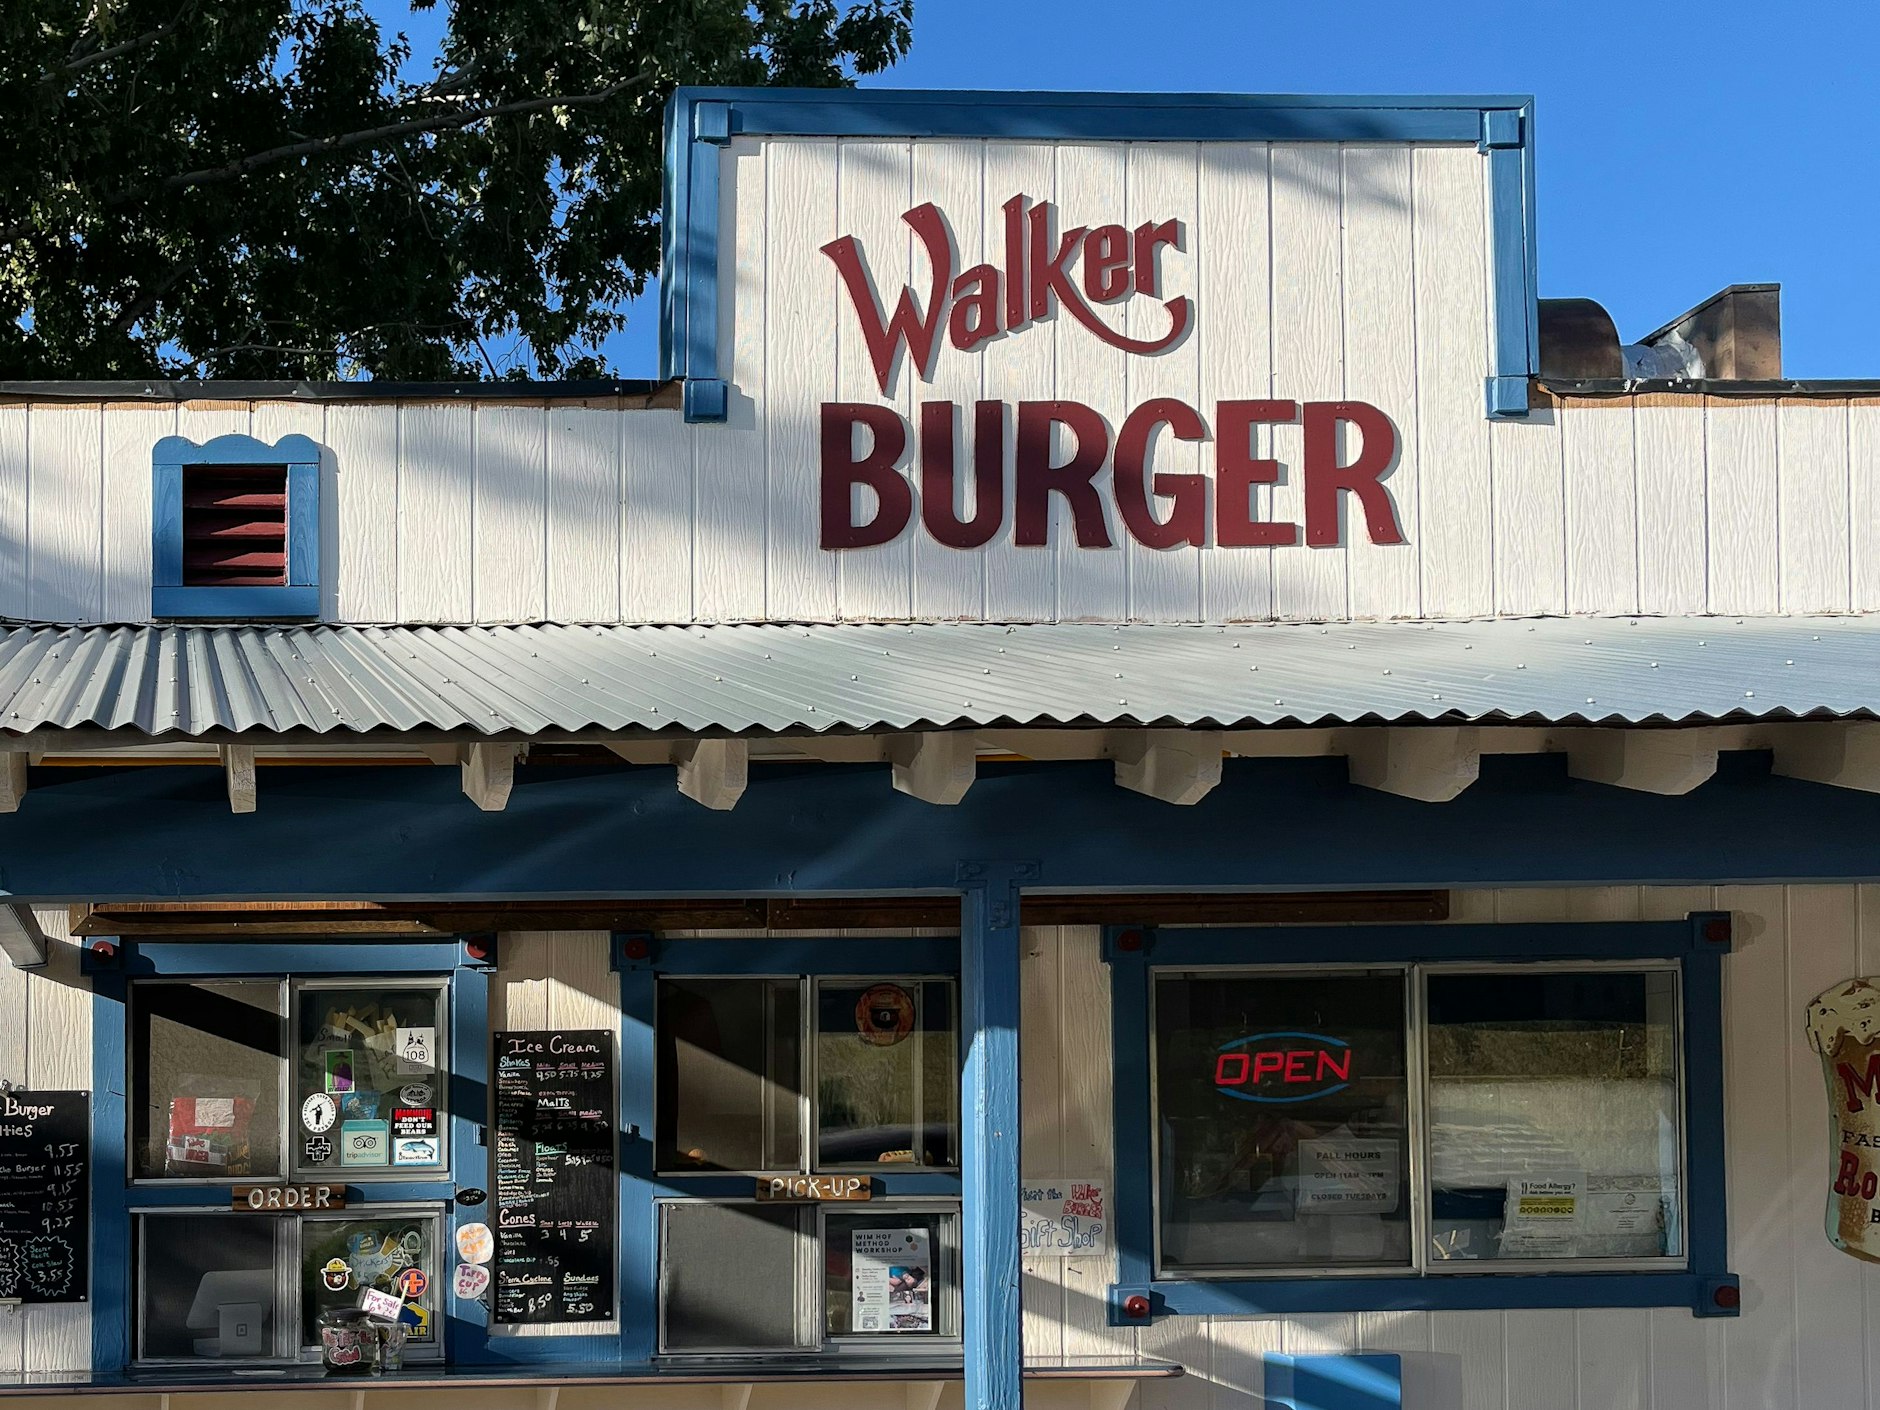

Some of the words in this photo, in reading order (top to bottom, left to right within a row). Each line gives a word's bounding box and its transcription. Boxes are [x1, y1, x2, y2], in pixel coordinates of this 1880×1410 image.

[820, 192, 1194, 396] Walker
[820, 397, 1404, 551] BURGER
[508, 1038, 544, 1055] Ice
[549, 1035, 601, 1055] Cream
[406, 1050, 426, 1061] 108
[1215, 1049, 1352, 1085] OPEN
[4, 1097, 55, 1120] Burger
[346, 1151, 382, 1160] tripadvisor
[1345, 1151, 1382, 1160] HOURS
[16, 1164, 47, 1174] Burger
[770, 1177, 861, 1199] PICK-UP
[1549, 1182, 1576, 1191] Allergy?
[248, 1187, 331, 1209] ORDER
[1345, 1192, 1387, 1200] TUESDAYS
[41, 1216, 74, 1234] 9.25
[499, 1208, 536, 1225] Cones
[541, 1229, 550, 1240] 3
[560, 1228, 567, 1241] 4
[578, 1229, 593, 1243] 5
